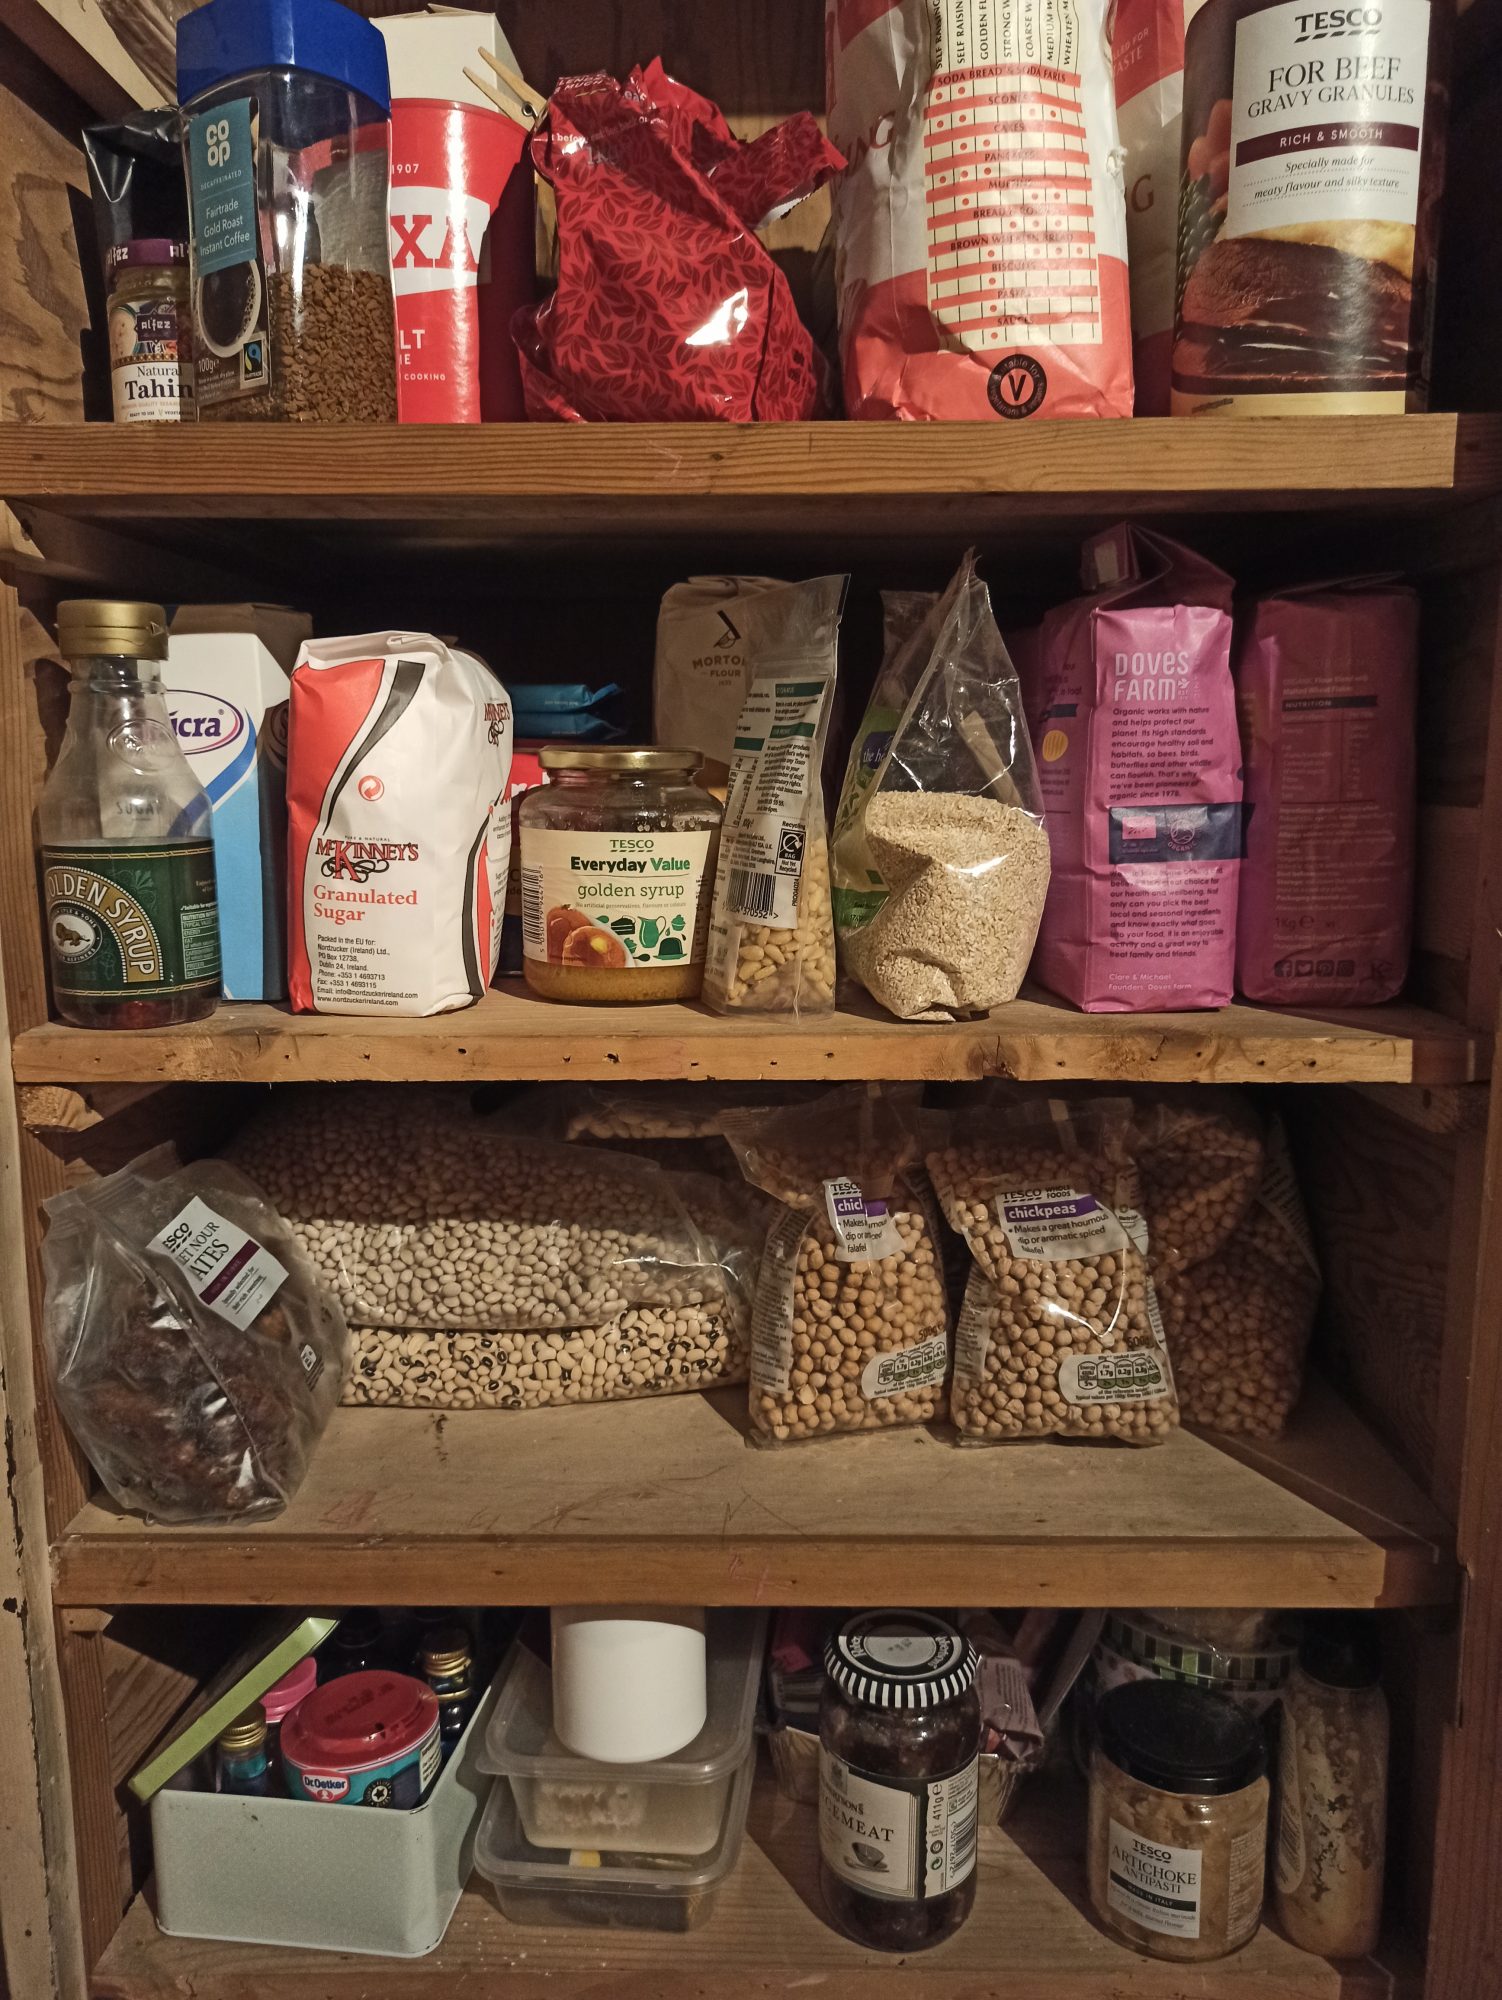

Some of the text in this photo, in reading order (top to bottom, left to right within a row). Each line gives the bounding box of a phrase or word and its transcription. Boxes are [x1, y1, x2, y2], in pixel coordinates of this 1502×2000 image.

[1295, 8, 1382, 33] TESCO
[956, 0, 965, 64] SELF RAISIN
[980, 13, 988, 60] GOLDEN
[1002, 12, 1012, 58] STRONG
[1025, 15, 1034, 58] COARSE
[938, 74, 966, 86] SODA
[969, 68, 1002, 79] BREAD
[1043, 71, 1066, 83] FARLS
[1268, 56, 1401, 93] FOR BEEF
[1248, 85, 1414, 119] GRAVY GRANULES
[1280, 128, 1383, 148] RICH & SMOOTH
[1285, 156, 1374, 173] Specially made for
[1254, 176, 1400, 199] meaty flavour and silky texture
[206, 199, 239, 220] Fairtrade
[204, 215, 243, 238] Gold Roast
[200, 240, 223, 257] Instant
[223, 231, 250, 248] Coffee
[390, 214, 480, 272] XA
[950, 237, 988, 251] BROWN
[137, 366, 182, 378] Natural
[404, 373, 446, 381] COOKING
[125, 378, 194, 400] Tahin
[1008, 374, 1026, 401] V
[710, 669, 741, 677] FLOUR
[1114, 678, 1176, 702] FARM
[1113, 708, 1145, 716] Organic
[1152, 729, 1169, 737] high
[1109, 792, 1137, 800] organic
[782, 821, 806, 830] Recycling
[609, 839, 655, 849] TESCO
[1167, 841, 1197, 852] ORGANIC
[570, 856, 691, 873] Everyday Value
[313, 884, 418, 905] Granulated
[577, 883, 684, 900] golden syrup
[313, 902, 365, 925] Sugar
[743, 906, 768, 919] 370552
[49, 873, 155, 975] OLDEN SYRUP
[318, 935, 337, 943] Packed
[365, 938, 376, 946] for:
[318, 944, 348, 952] Nordzucker
[350, 947, 375, 955] (Ireland)
[1165, 940, 1184, 948] great
[319, 969, 335, 977] Phone:
[337, 971, 352, 979] +353
[318, 996, 399, 1006] www.nordzuckerireland.com
[335, 988, 418, 998] info@nordzuckerireland.com
[1002, 1189, 1042, 1200] TESCO
[1047, 1191, 1071, 1199] FOODS
[1008, 1204, 1077, 1219] chickpeas
[843, 1219, 863, 1228] Makes
[1014, 1225, 1040, 1234] Makes
[1048, 1223, 1070, 1233] great
[1071, 1214, 1109, 1228] houmous
[190, 1221, 220, 1251] NOUR
[846, 1232, 856, 1241] dip
[1018, 1236, 1030, 1245] dip
[1041, 1232, 1078, 1243] aromatic
[1079, 1225, 1106, 1240] spiced
[848, 1243, 866, 1253] falafel
[189, 1238, 230, 1281] ATES
[933, 1796, 944, 1820] 411g
[1133, 1839, 1172, 1860] TESCO
[1112, 1845, 1197, 1885] ARTICHOKE
[1124, 1865, 1181, 1894] ANTIPASTI
